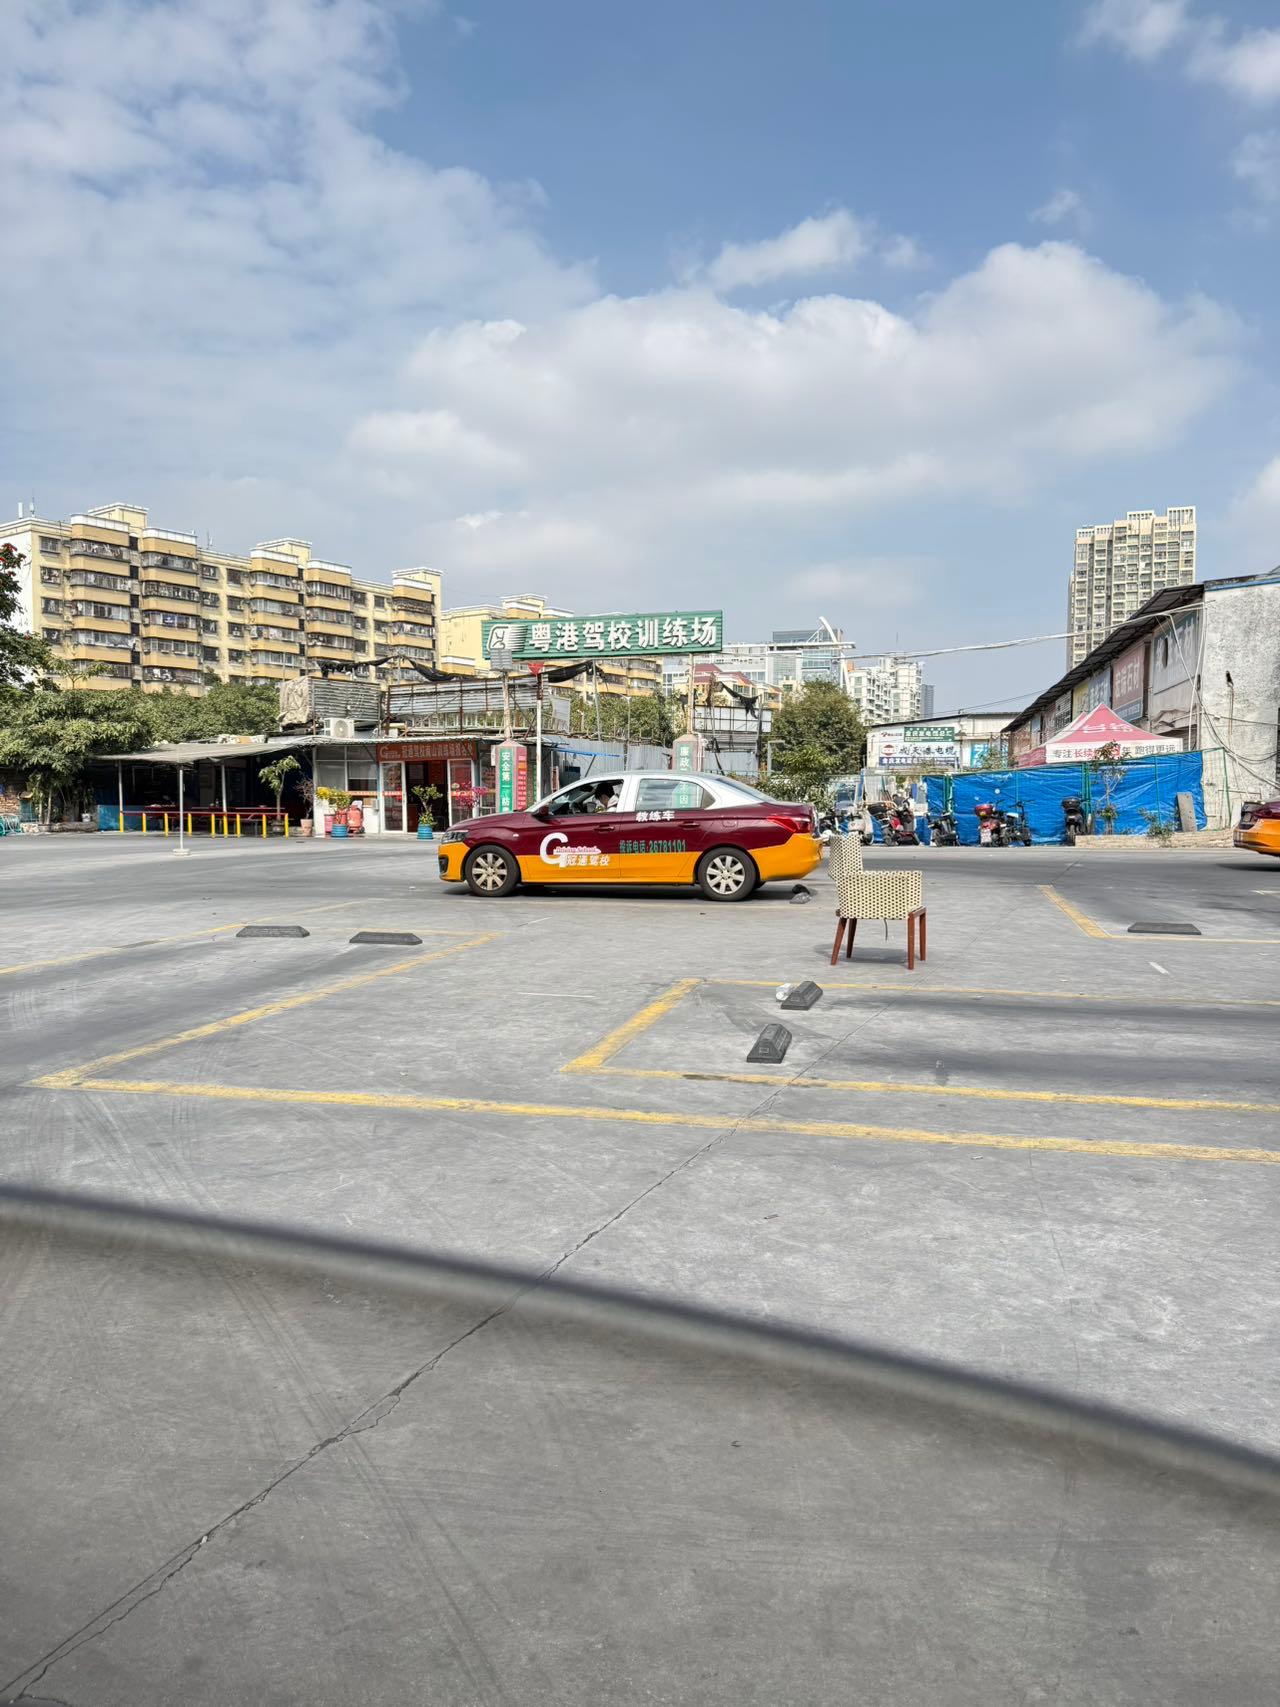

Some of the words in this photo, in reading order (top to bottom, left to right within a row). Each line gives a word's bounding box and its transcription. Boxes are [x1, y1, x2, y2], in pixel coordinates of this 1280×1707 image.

[529, 617, 717, 652] 粤港驾校训练场
[635, 810, 675, 822] 教练车
